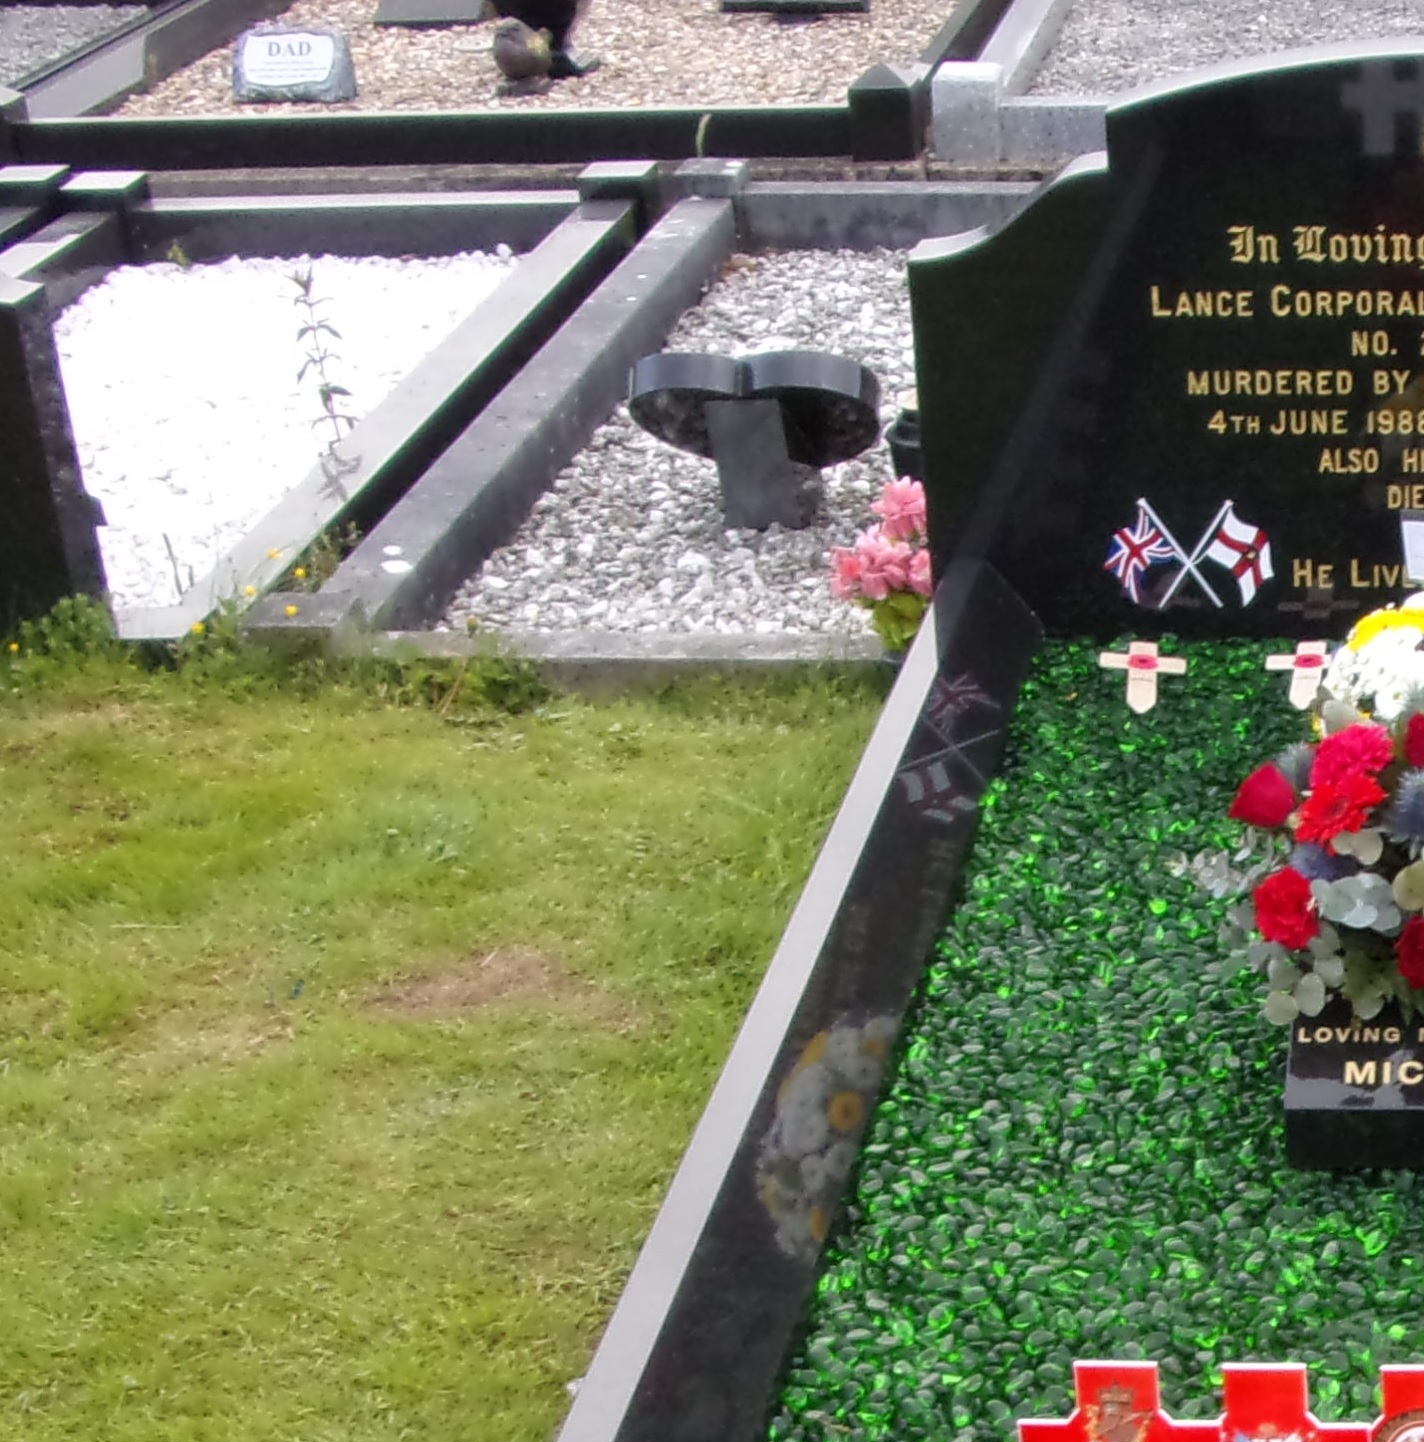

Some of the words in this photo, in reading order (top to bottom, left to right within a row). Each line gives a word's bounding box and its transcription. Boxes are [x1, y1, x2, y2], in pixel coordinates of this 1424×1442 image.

[268, 41, 311, 57] DAD
[1228, 226, 1279, 263] In
[1152, 286, 1253, 316] LANCE
[1352, 331, 1397, 356] NO.
[1188, 371, 1352, 395] MURDERED
[1374, 370, 1409, 395] BY
[1270, 410, 1347, 434] JUNE
[1319, 448, 1378, 473] ALSO
[1294, 559, 1333, 589] HE
[1298, 1027, 1400, 1043] LOVING
